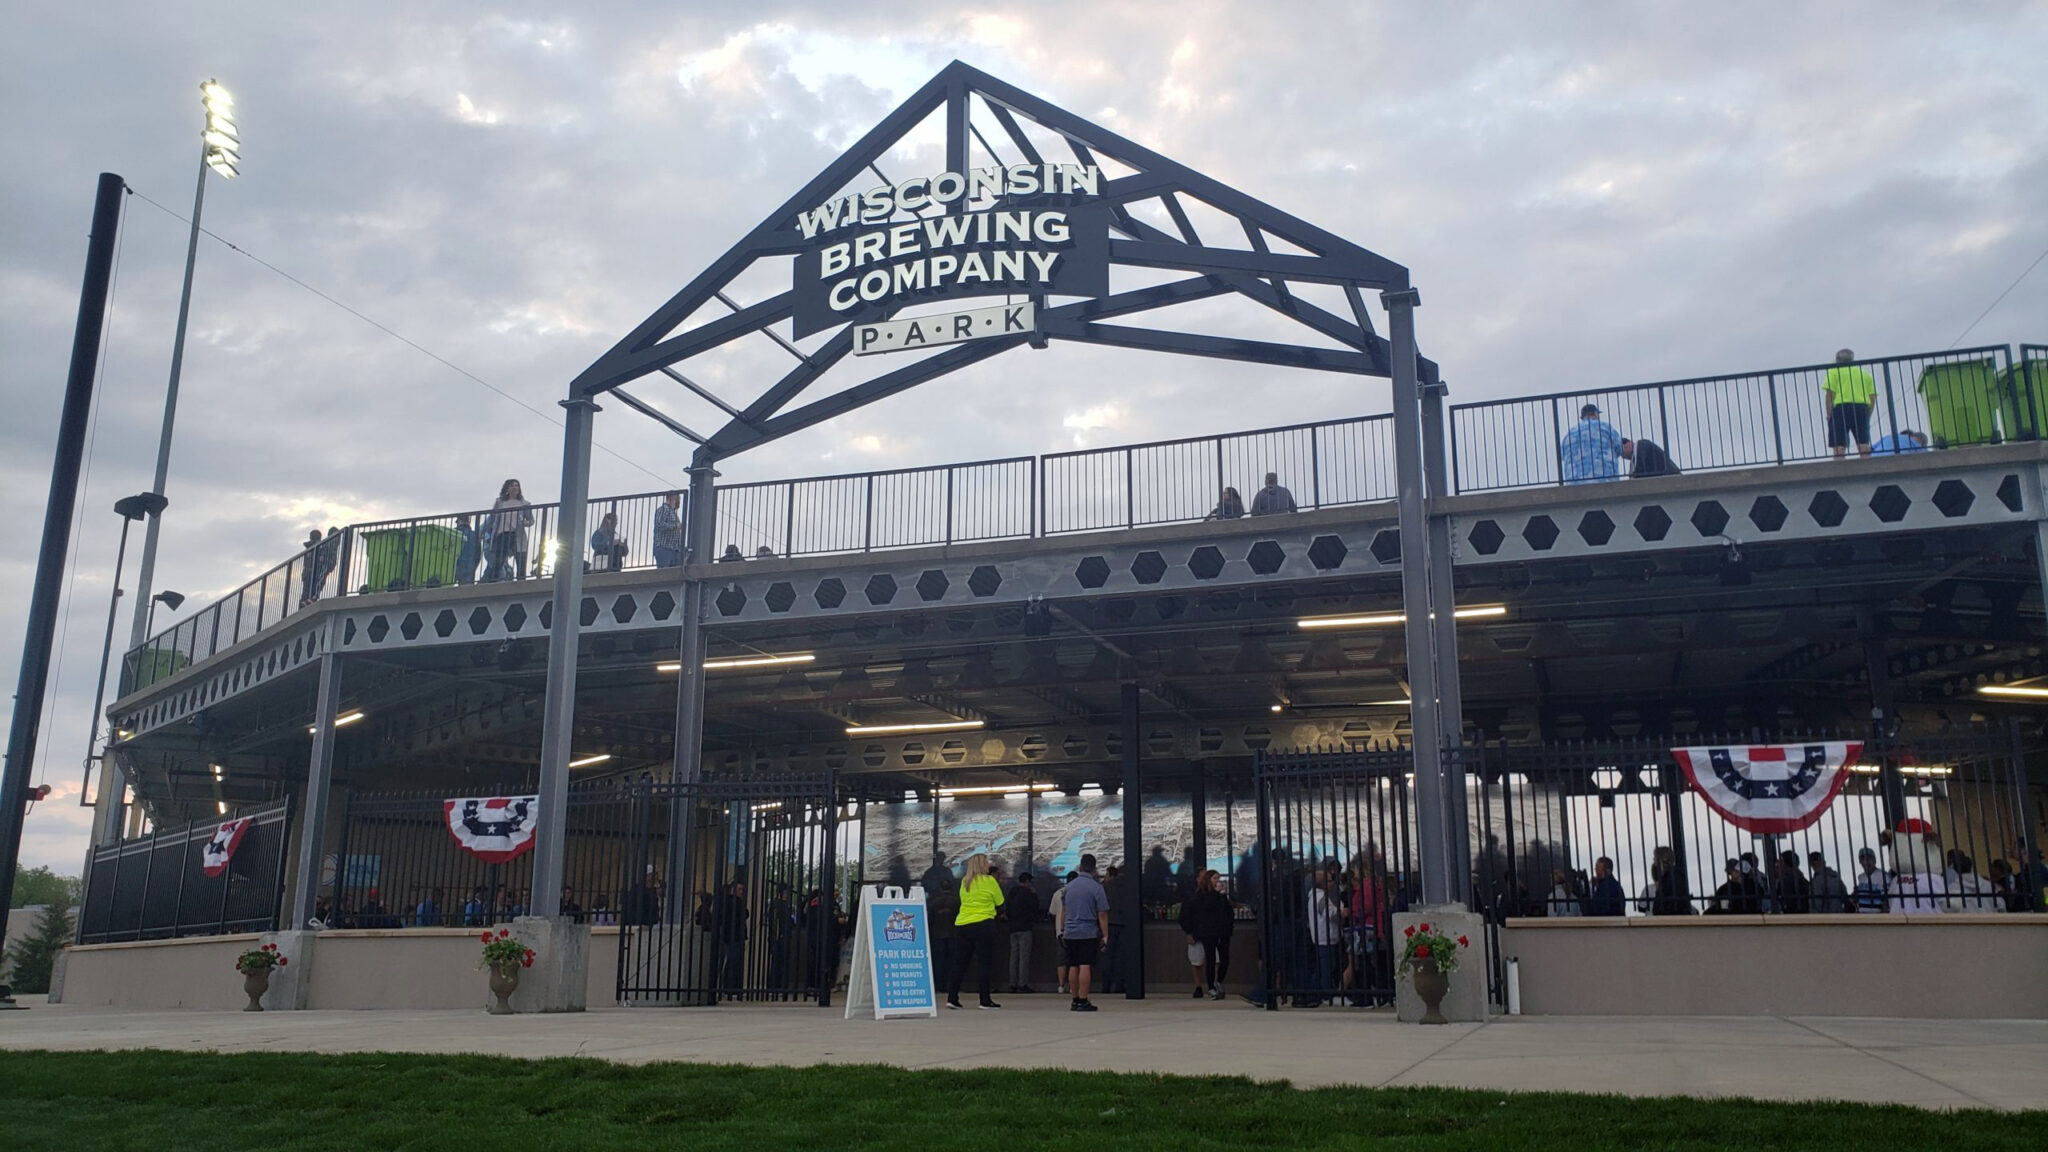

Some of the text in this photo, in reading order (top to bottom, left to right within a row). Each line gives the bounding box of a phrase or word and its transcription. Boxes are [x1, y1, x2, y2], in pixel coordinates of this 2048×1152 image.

[798, 163, 1099, 240] WISCONSIN
[820, 211, 1071, 280] BREWING
[828, 250, 1060, 312] COMPANY
[878, 949, 925, 959] PARK RULES
